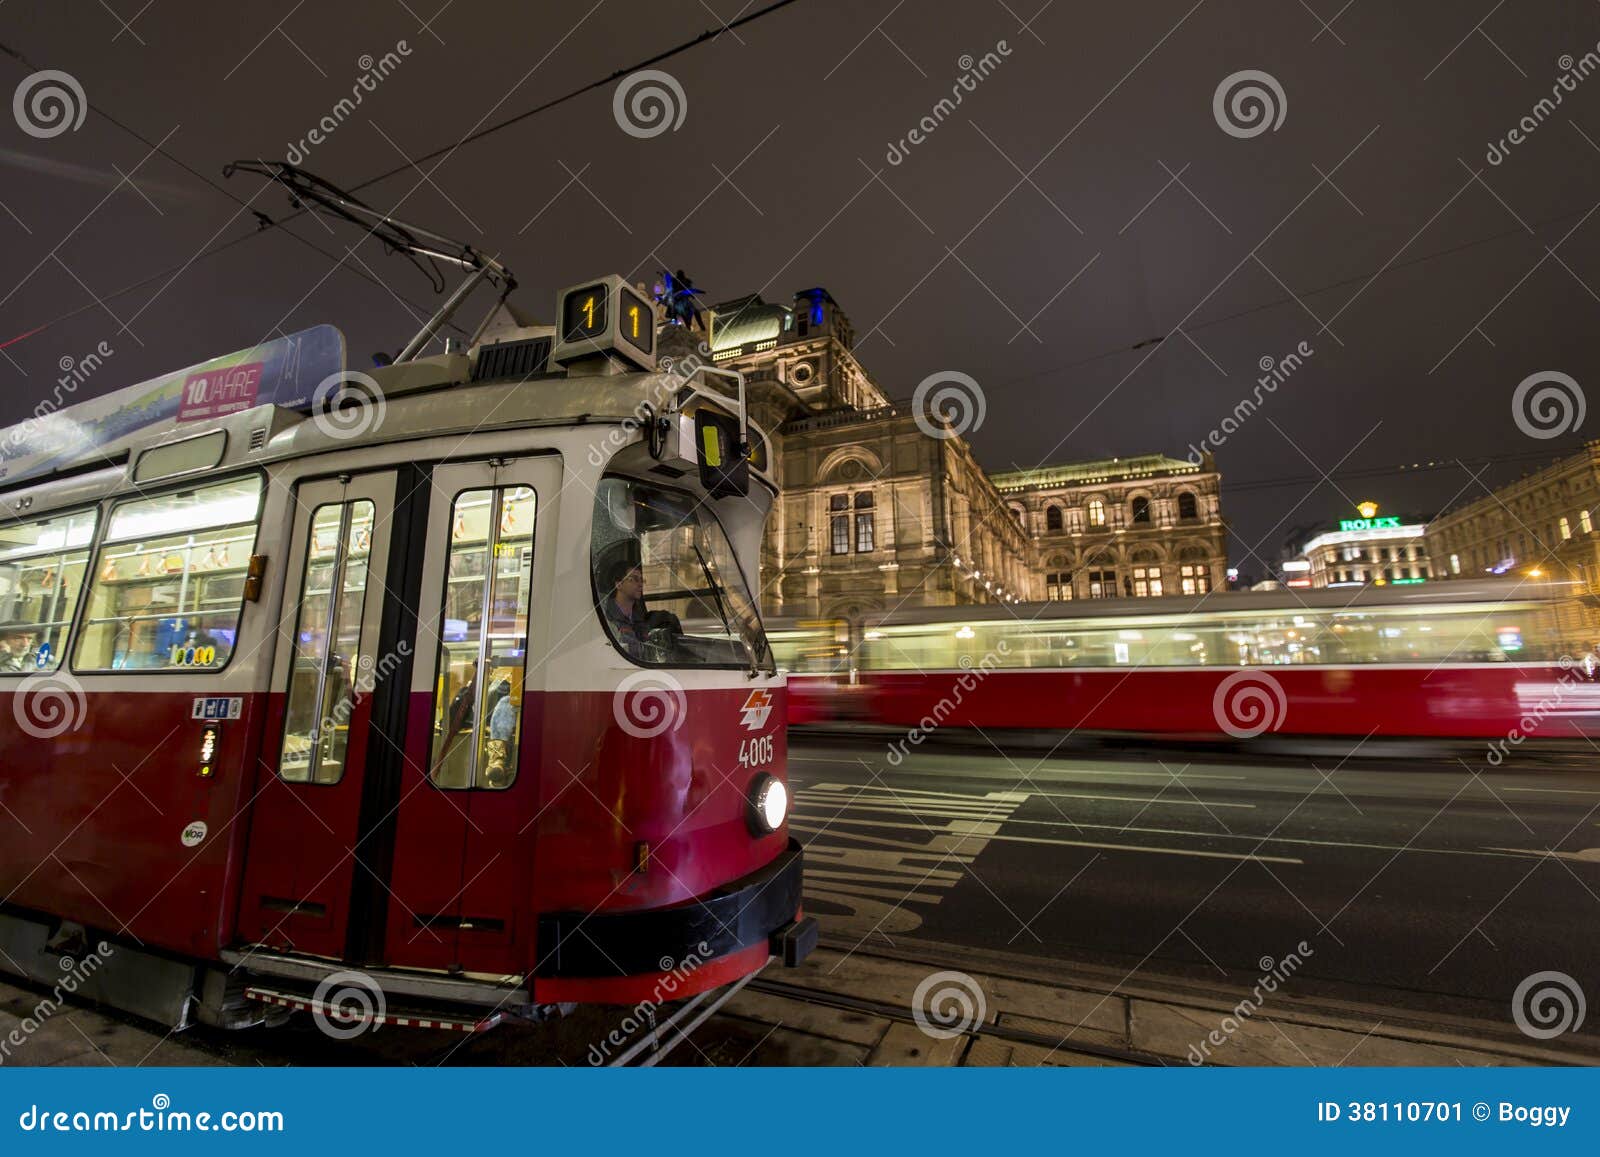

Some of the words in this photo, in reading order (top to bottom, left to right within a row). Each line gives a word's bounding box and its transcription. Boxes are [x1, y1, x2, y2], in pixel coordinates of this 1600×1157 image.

[582, 297, 594, 328] 1
[629, 306, 640, 338] 1
[203, 369, 257, 402] JAHRE
[1340, 517, 1400, 531] ROLEX
[738, 735, 773, 769] 4005
